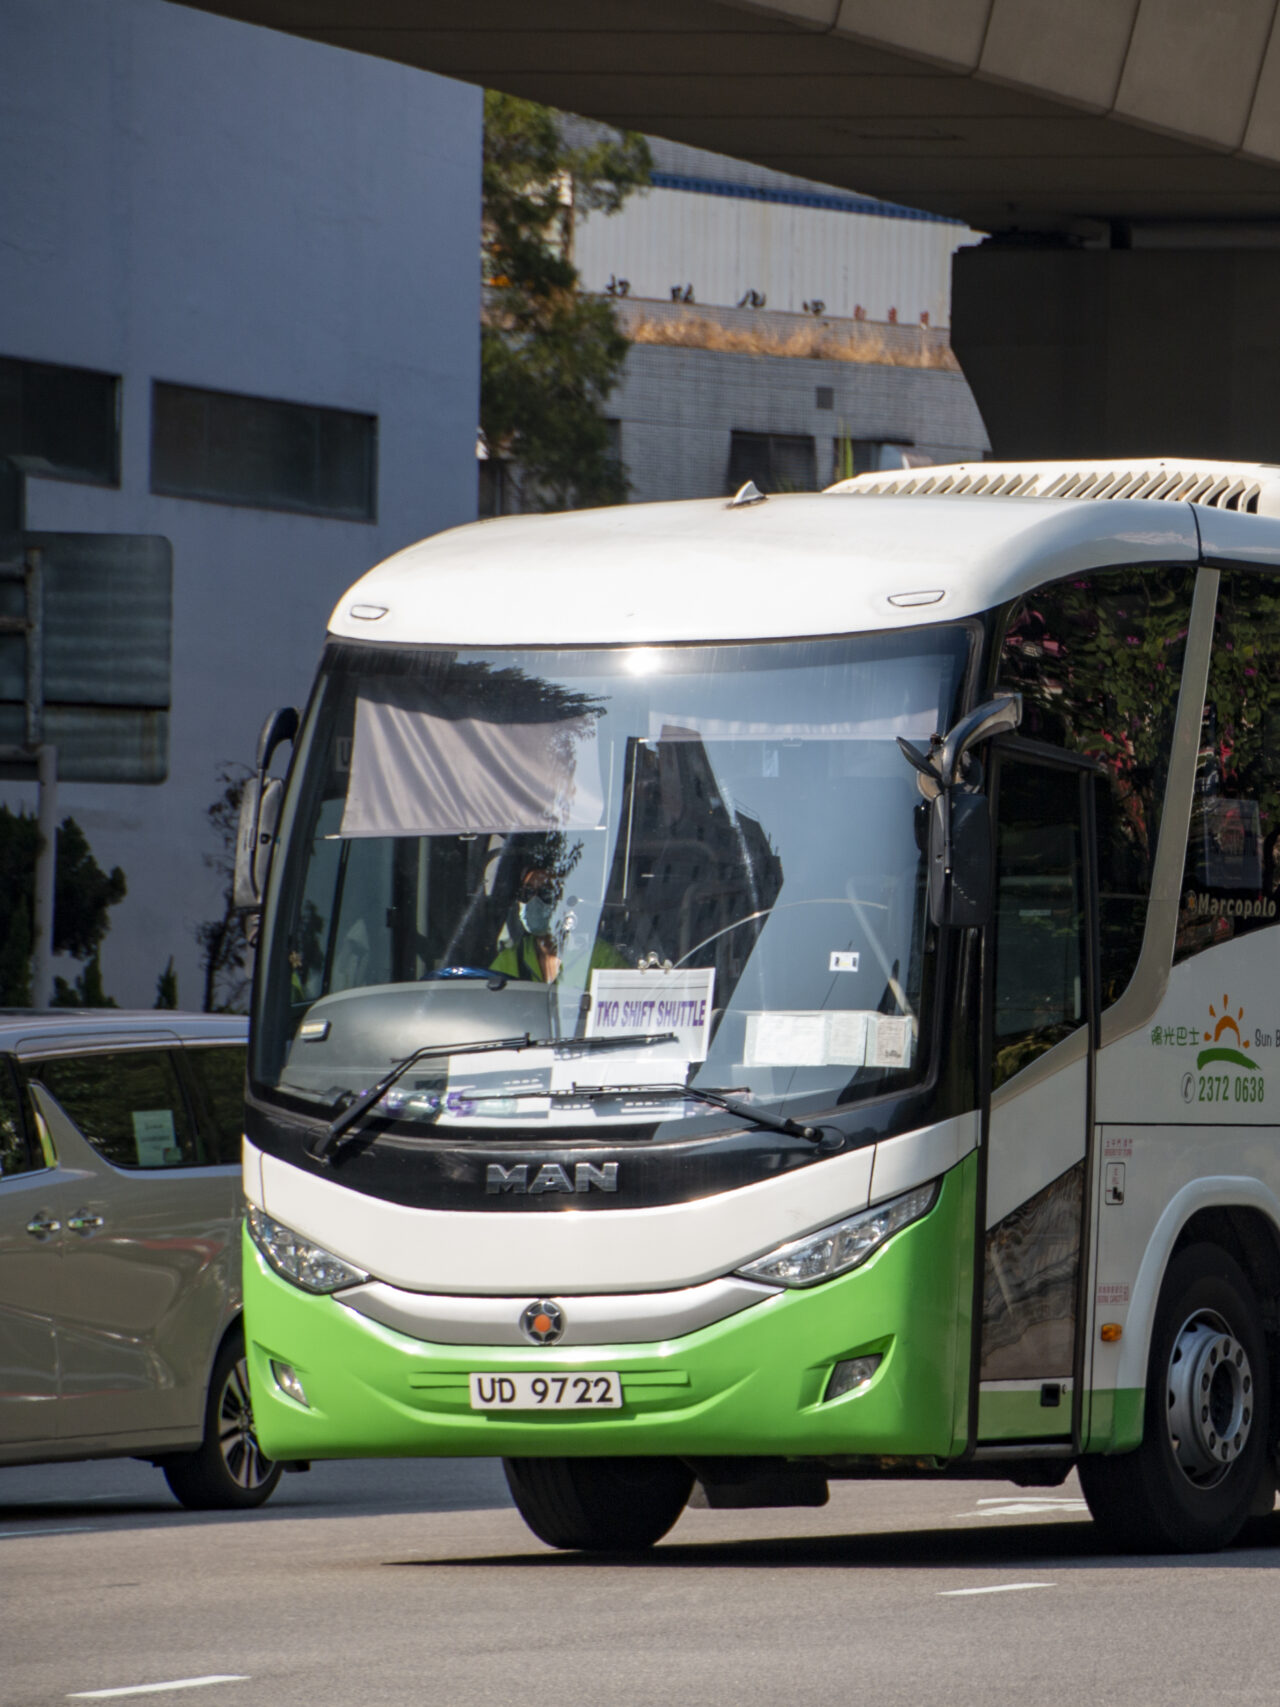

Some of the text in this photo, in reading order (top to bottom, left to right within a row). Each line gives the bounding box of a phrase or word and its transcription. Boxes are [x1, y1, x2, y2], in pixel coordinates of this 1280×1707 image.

[1198, 893, 1277, 919] Marcopolo
[596, 1000, 706, 1027] TKO SHIFT SHUTTLE
[1151, 1025, 1200, 1047] 陽光巴士
[1254, 1028, 1272, 1047] Sun
[1198, 1076, 1265, 1102] 2372 0638
[487, 1162, 620, 1194] MAN
[477, 1377, 614, 1403] UD 9722
